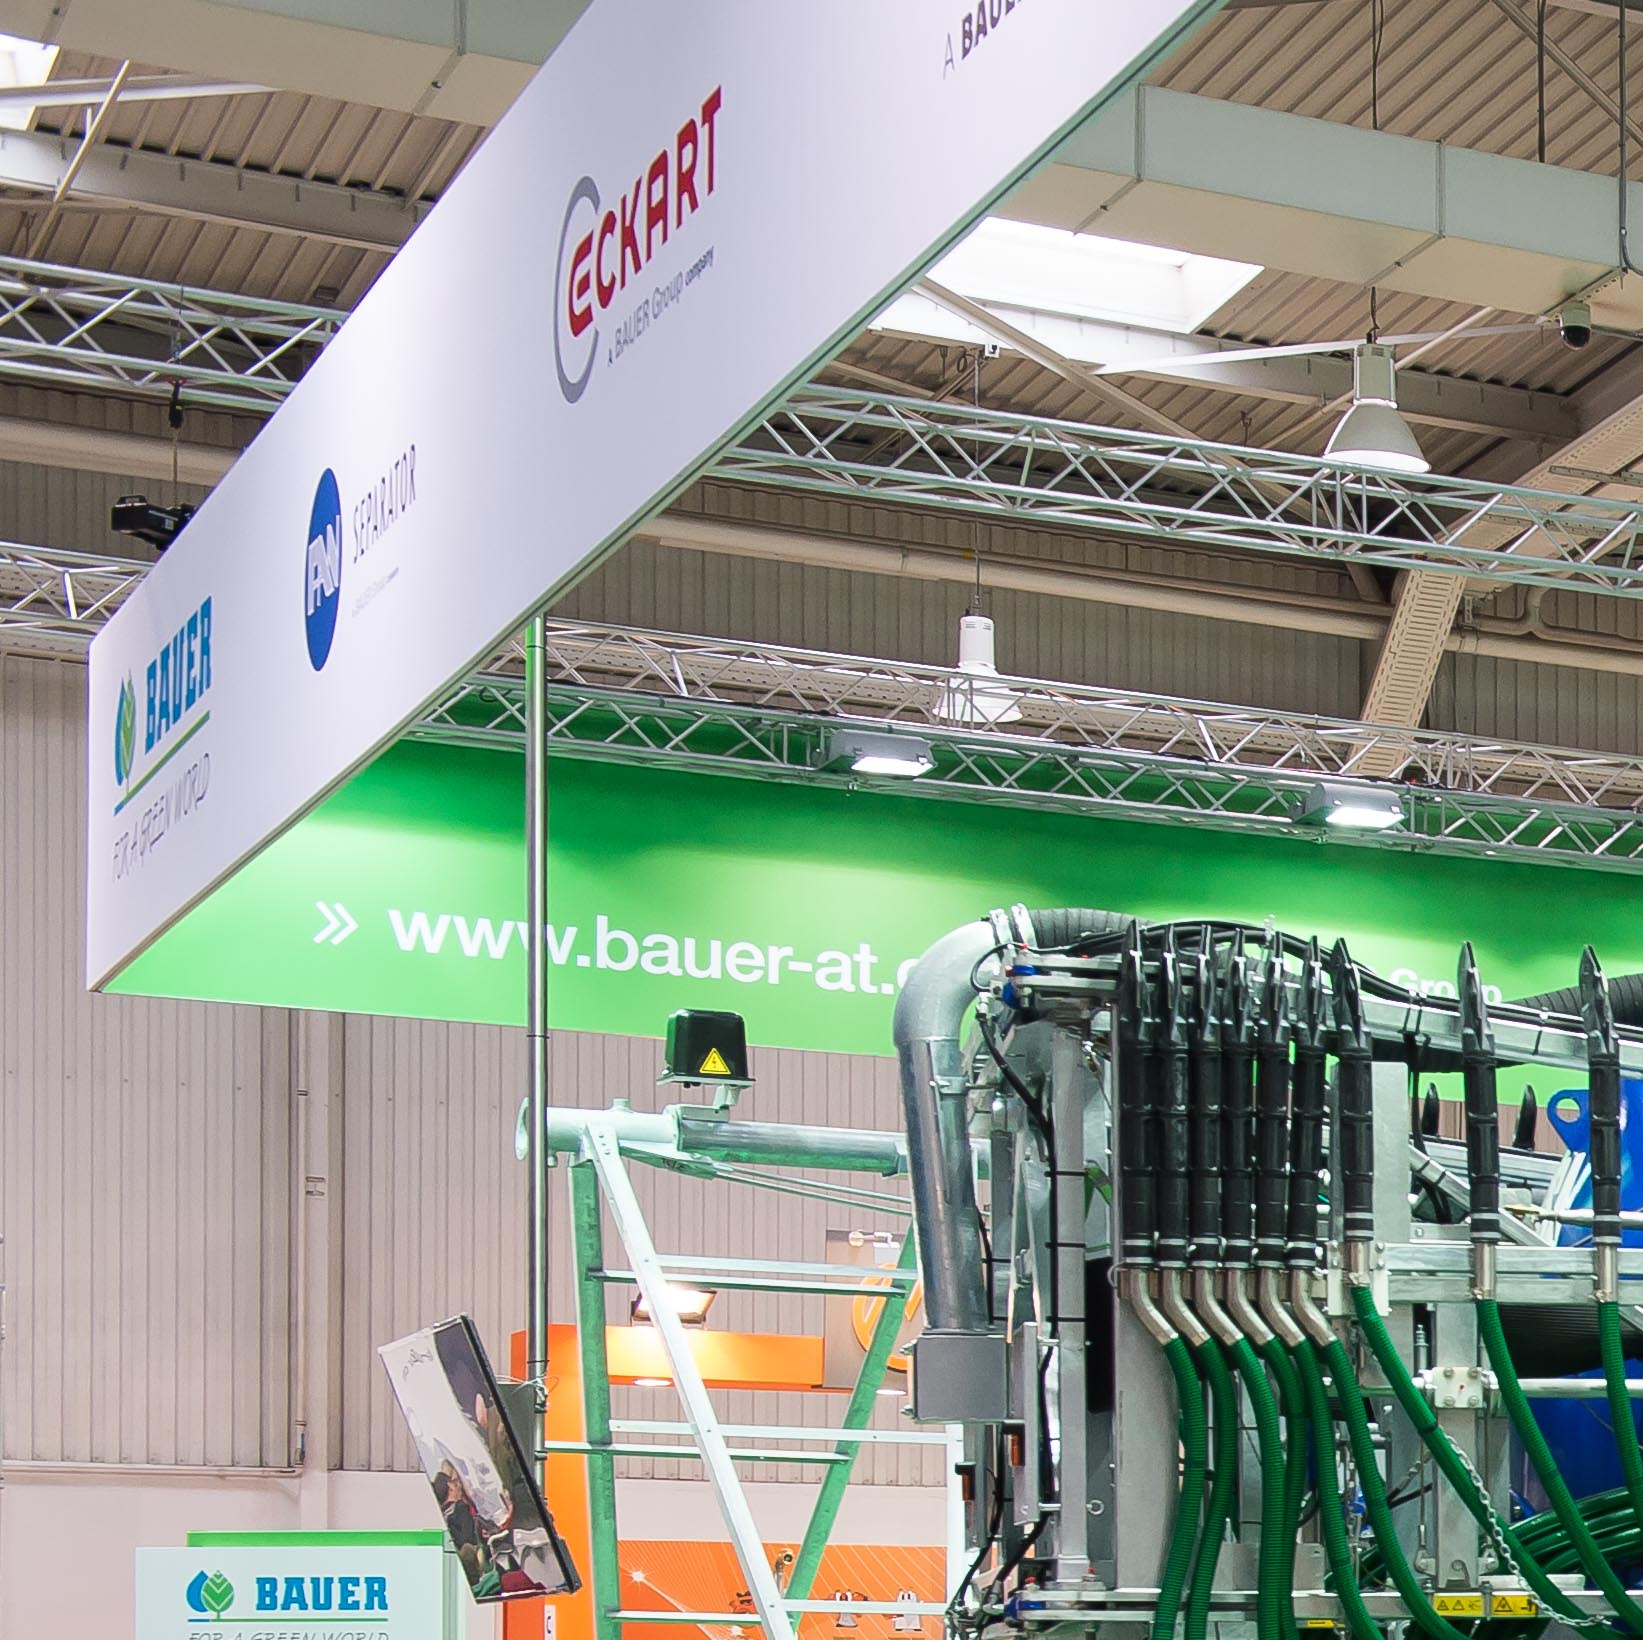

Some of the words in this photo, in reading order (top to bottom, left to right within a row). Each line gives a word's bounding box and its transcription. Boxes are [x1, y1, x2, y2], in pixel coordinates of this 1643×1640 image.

[962, 0, 1020, 60] BAU
[567, 85, 721, 338] ECKART
[615, 299, 650, 359] BAUER
[651, 271, 684, 320] Group
[353, 444, 416, 564] SEPARATOR
[145, 595, 212, 755] BAUER
[256, 1576, 388, 1611] BAUER
